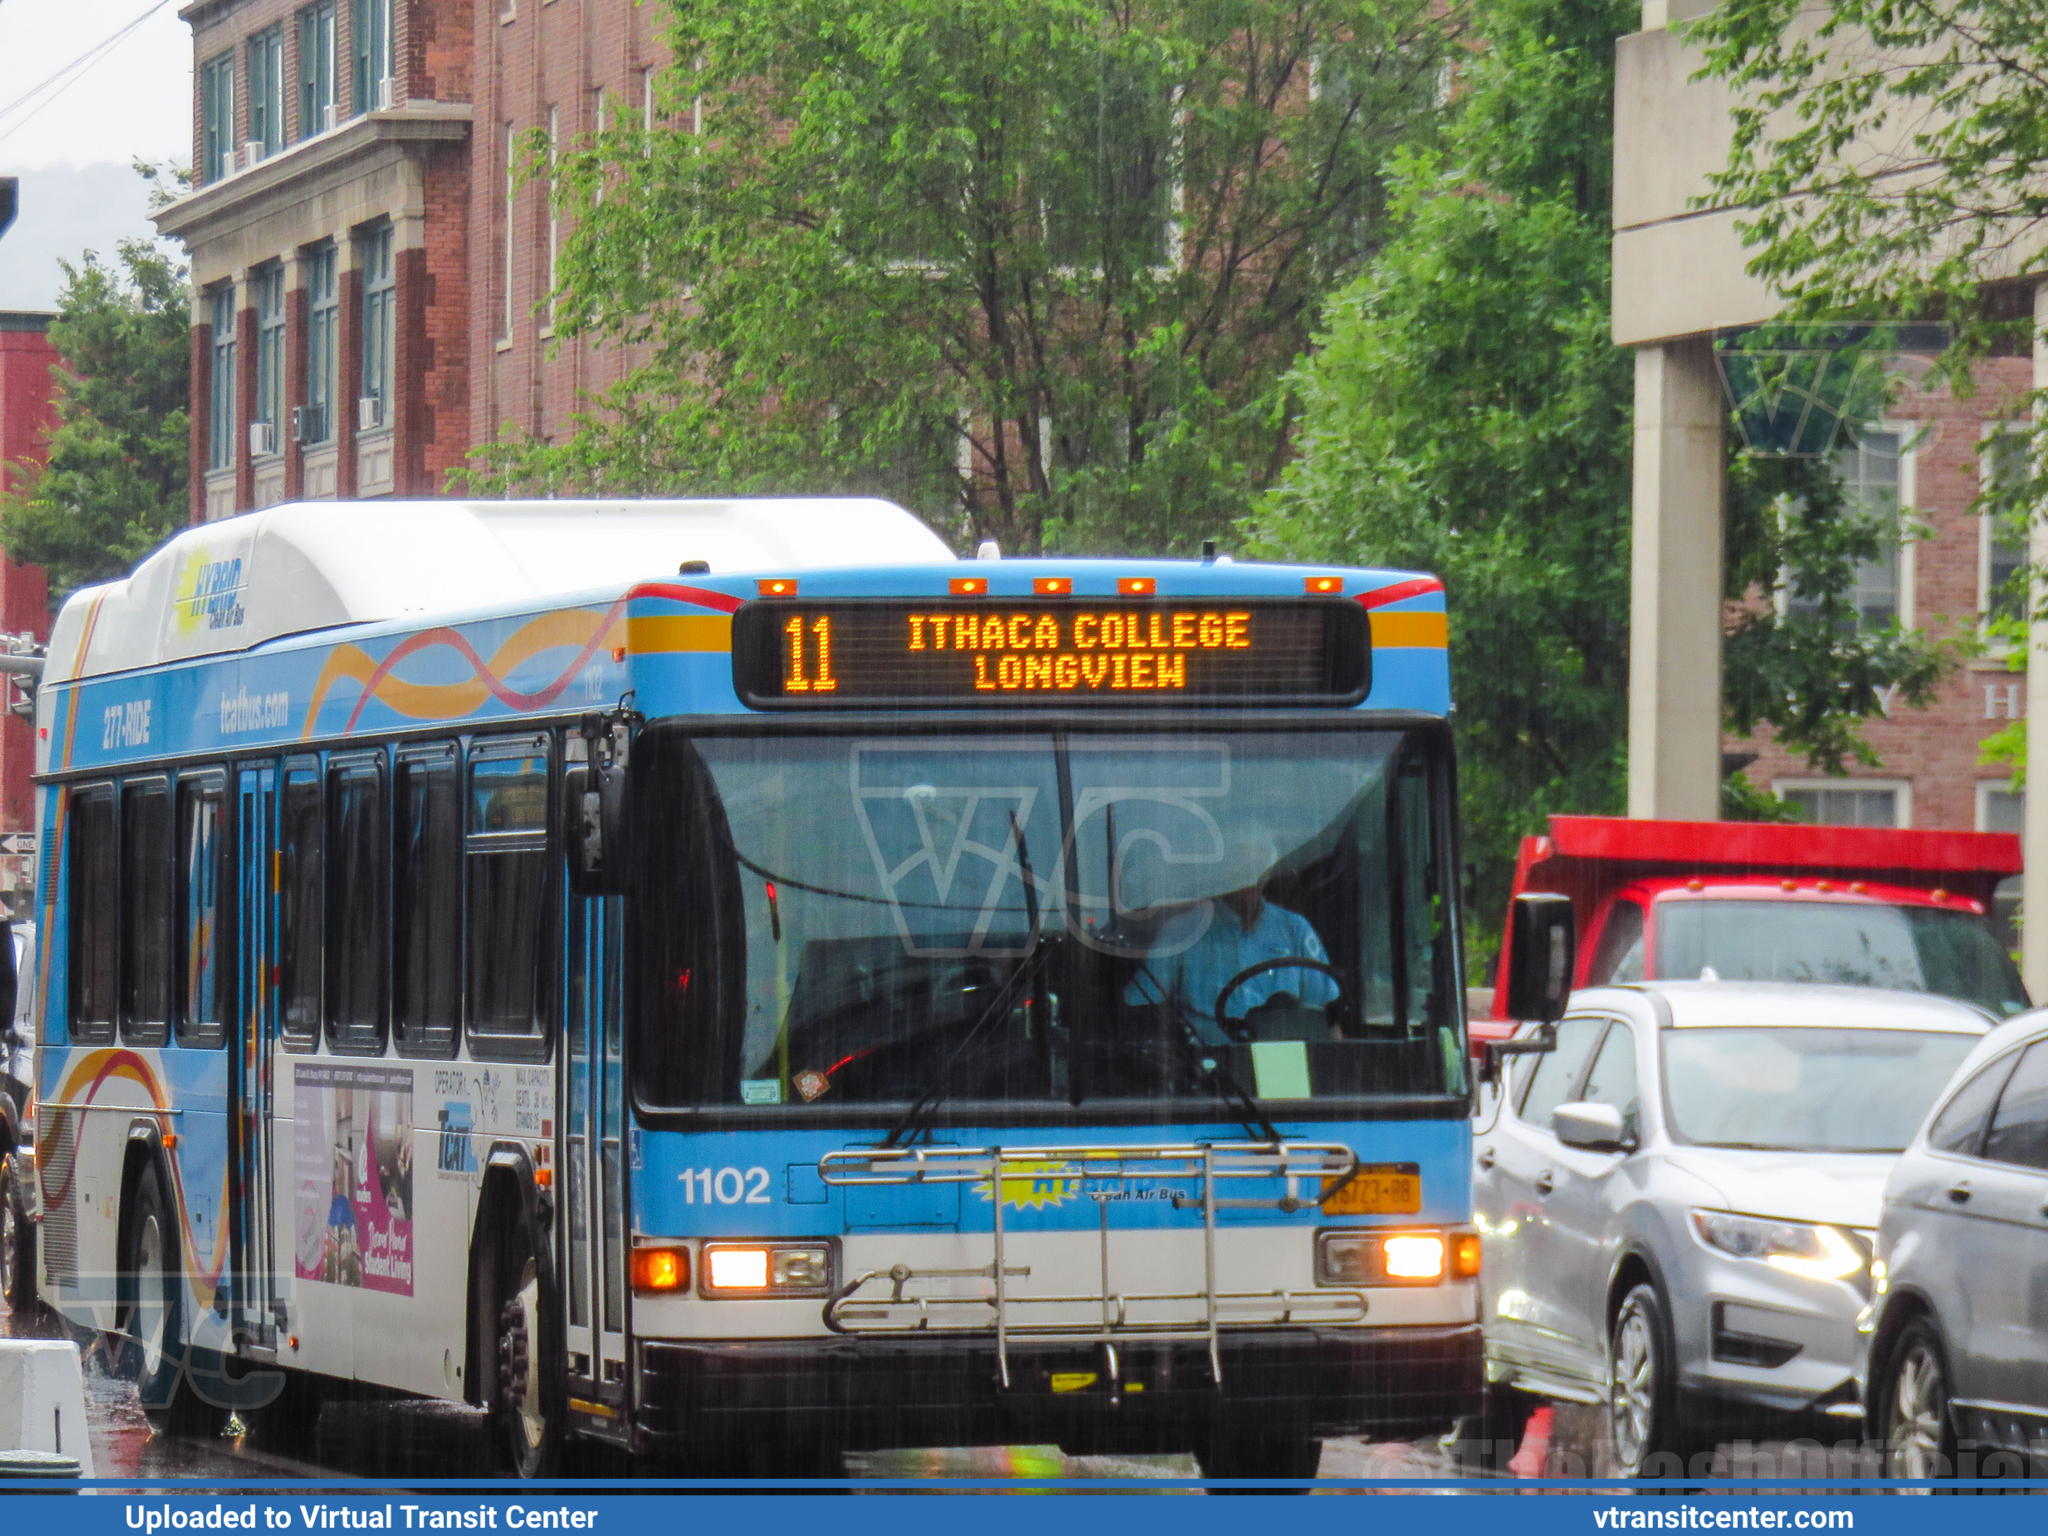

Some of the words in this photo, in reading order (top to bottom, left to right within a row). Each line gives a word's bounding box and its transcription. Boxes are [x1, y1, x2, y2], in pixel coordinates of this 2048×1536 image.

[908, 613, 1059, 651] ITHACA
[1072, 612, 1252, 649] COLLEGE
[784, 615, 837, 692] 11
[974, 653, 1187, 690] LONGVIEW
[103, 699, 151, 750] 277-RIDE
[221, 686, 289, 734] tcatbus.com
[16, 840, 35, 849] ONE
[677, 1167, 771, 1204] 1102
[1135, 1188, 1155, 1201] Air
[1160, 1187, 1186, 1201] Bus
